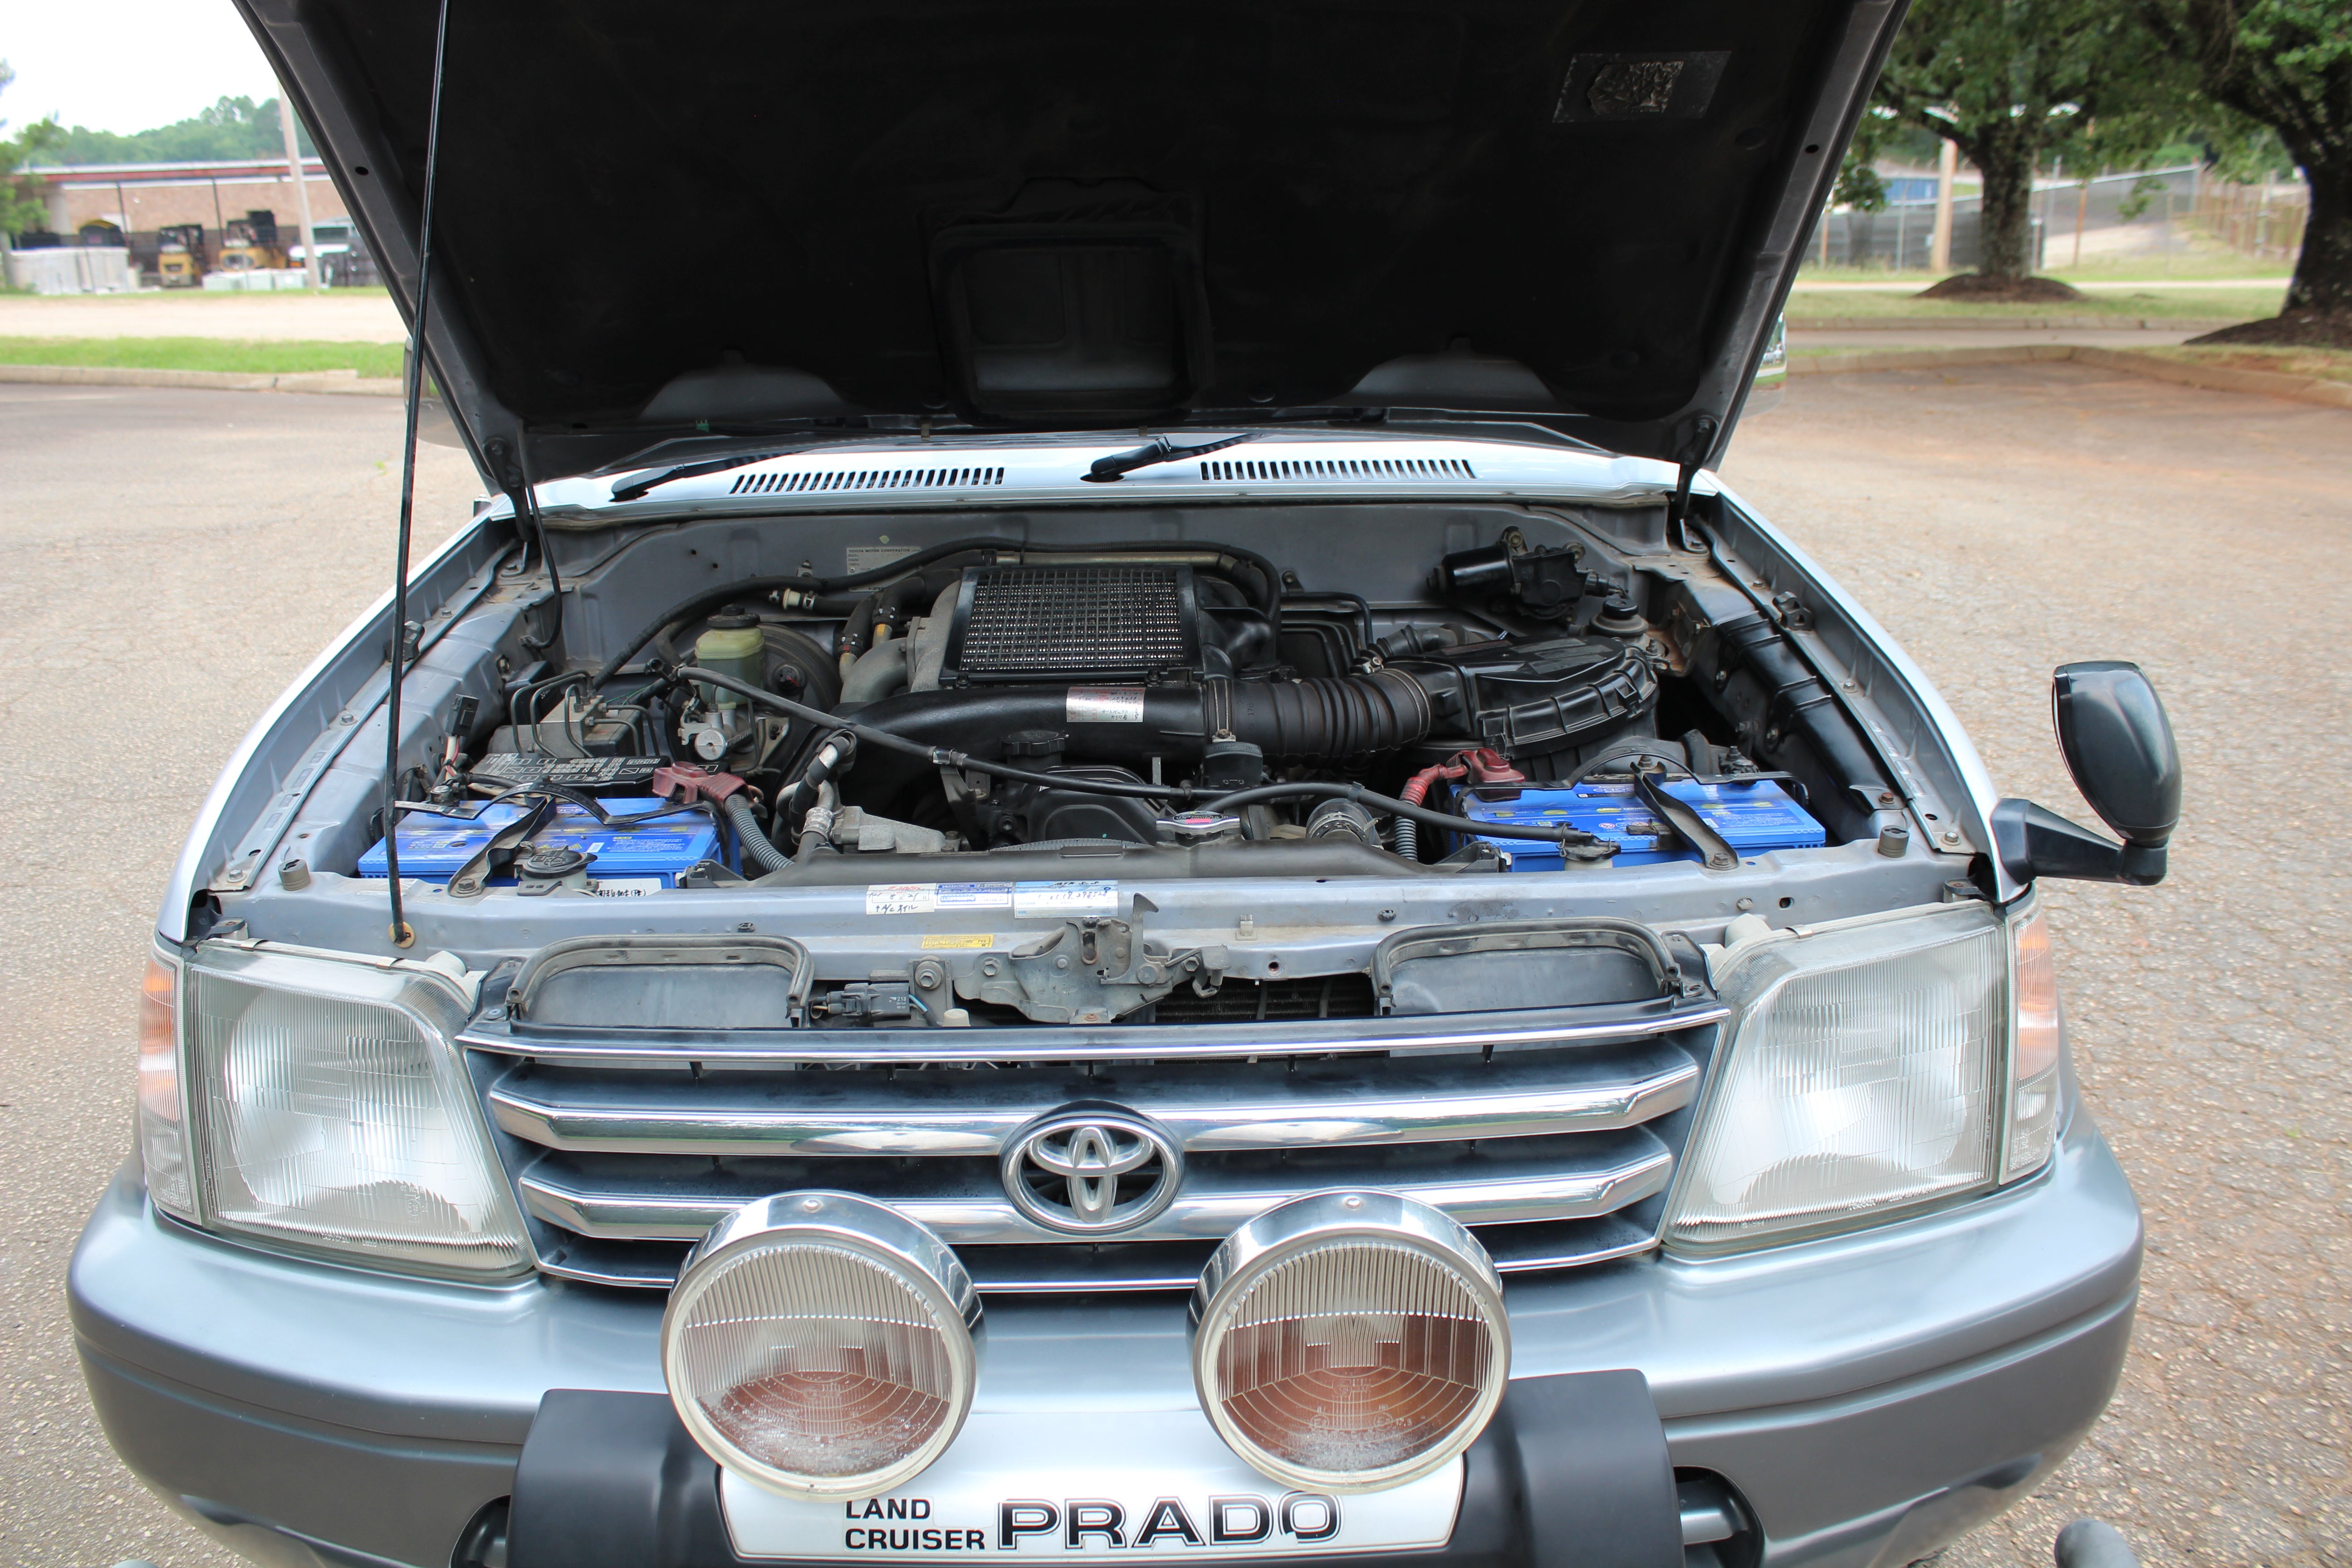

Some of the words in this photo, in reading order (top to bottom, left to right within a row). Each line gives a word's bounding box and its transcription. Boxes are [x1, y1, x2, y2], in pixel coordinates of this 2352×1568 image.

[845, 1499, 931, 1520] LAND
[997, 1492, 1342, 1550] PRADO
[845, 1528, 985, 1550] CRUISER
